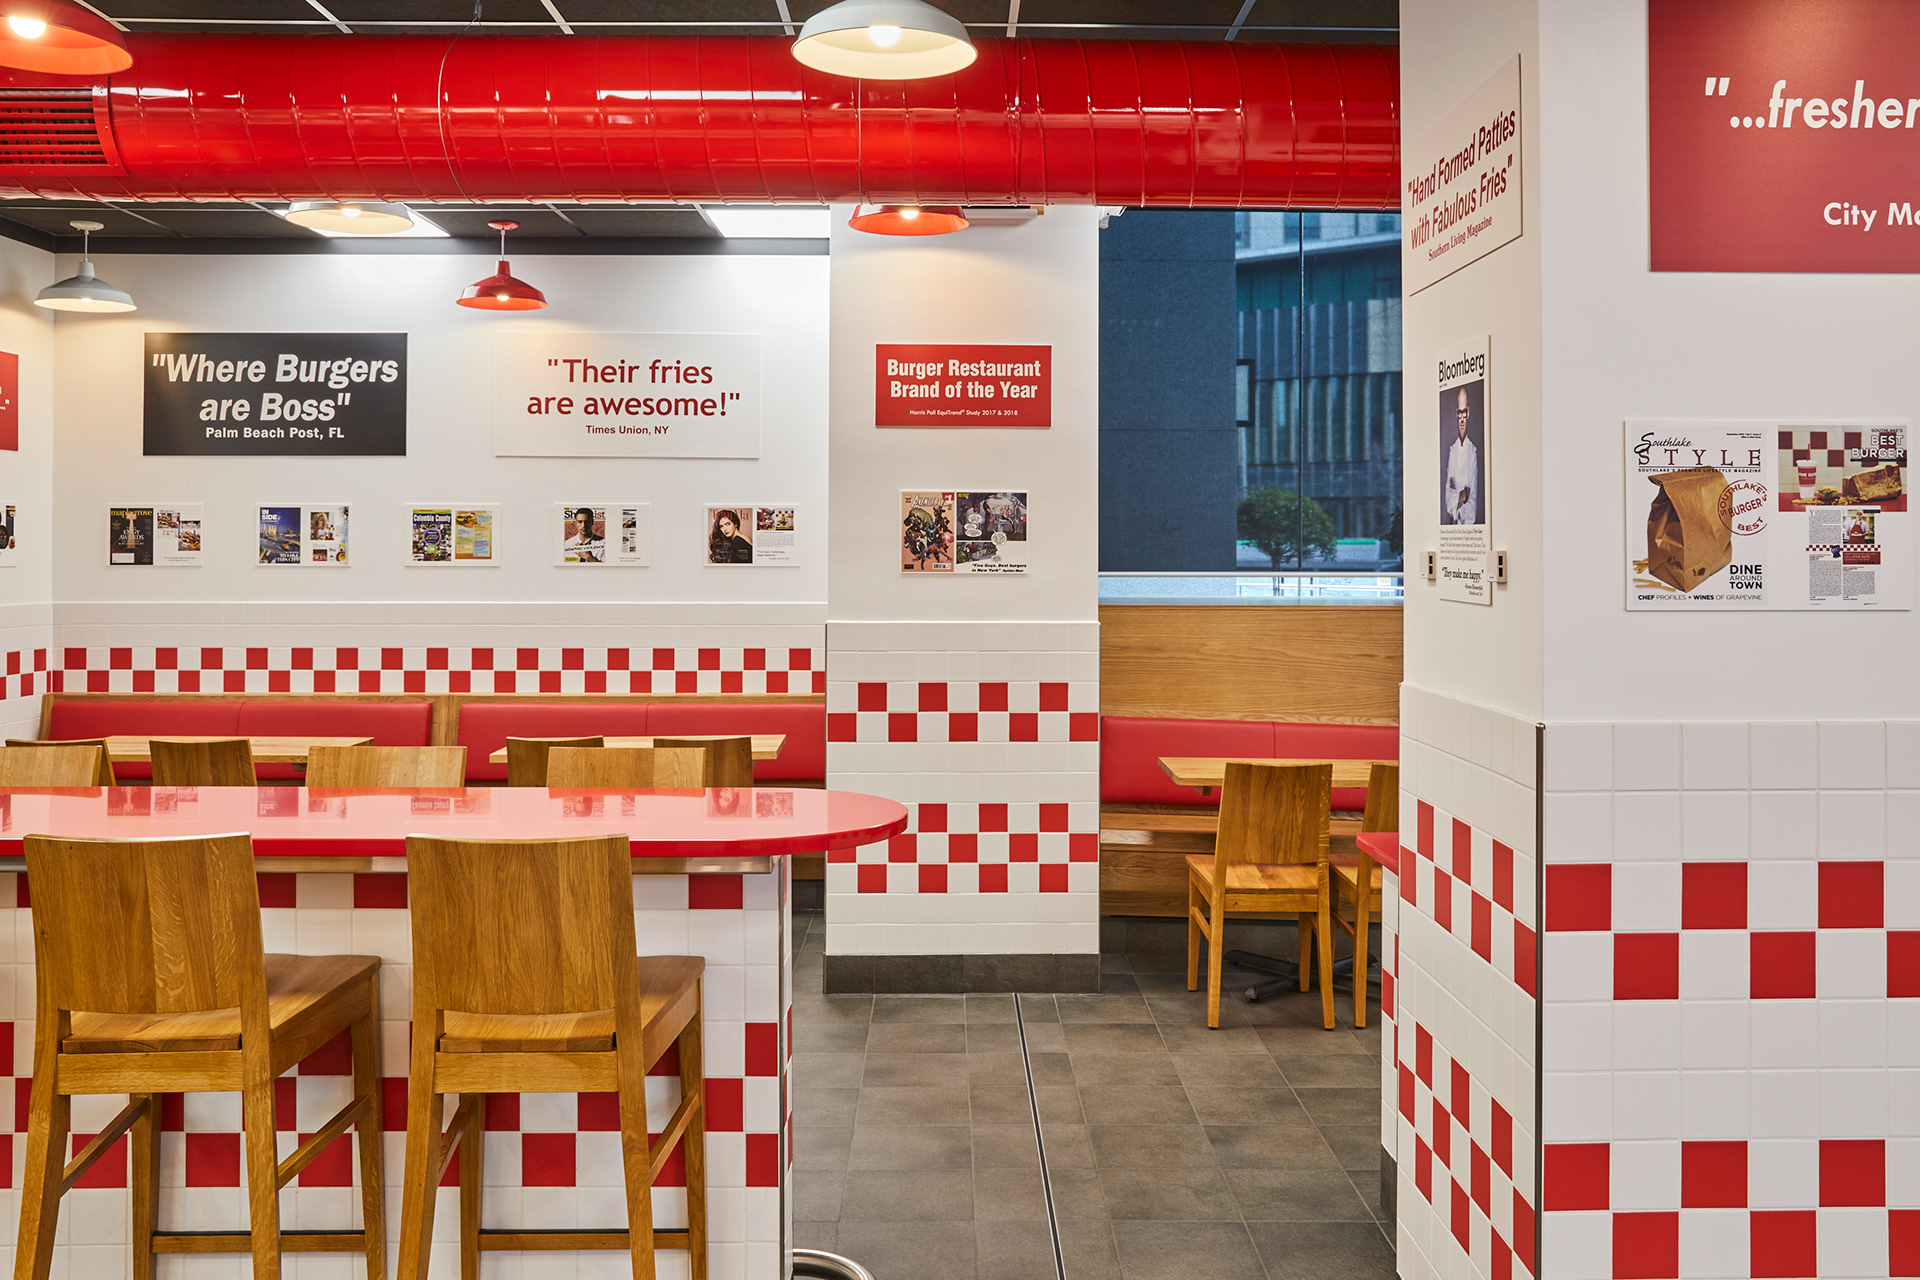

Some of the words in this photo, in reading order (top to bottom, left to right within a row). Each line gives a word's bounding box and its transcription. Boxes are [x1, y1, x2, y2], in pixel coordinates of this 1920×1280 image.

[1408, 163, 1436, 208] "Hand
[1438, 133, 1476, 190] Formed
[1478, 110, 1515, 161] Patties
[1411, 213, 1430, 250] with
[1432, 188, 1477, 238] Fabulous
[1479, 153, 1513, 207] Fries"
[1823, 202, 1877, 231] City
[1428, 240, 1450, 261] Southern
[1450, 231, 1466, 249] Living
[1466, 215, 1493, 239] Magazine
[152, 353, 266, 383] "Where
[275, 353, 399, 389] Burgers
[547, 358, 640, 384] "Their
[649, 359, 713, 384] fries
[887, 359, 944, 380] Burger
[948, 359, 1041, 377] Restaurant
[1439, 352, 1484, 382] Bloomberg
[890, 381, 940, 398] Brand
[944, 381, 963, 398] of
[967, 381, 994, 398] the
[1000, 381, 1038, 399] Year
[199, 398, 250, 421] are
[260, 392, 351, 421] Boss"
[527, 395, 574, 415] are
[583, 392, 740, 417] awesome!"
[206, 427, 238, 438] Palm
[243, 427, 285, 438] Beach
[290, 427, 324, 440] Post,
[329, 427, 345, 438] FL
[586, 425, 616, 434] Times
[619, 425, 651, 436] Union,
[654, 426, 669, 435] NY
[1870, 435, 1904, 446] BEST
[1633, 432, 1693, 454] Southlake
[1851, 448, 1904, 458] BURGER
[1638, 448, 1761, 466] STYLE
[1719, 482, 1768, 516] SOUTHLAKE'S
[1727, 498, 1763, 518] BURGER
[435, 514, 451, 523] County
[1737, 516, 1764, 532] BEST
[1729, 564, 1763, 575] DINE
[1729, 581, 1763, 589] TOWN
